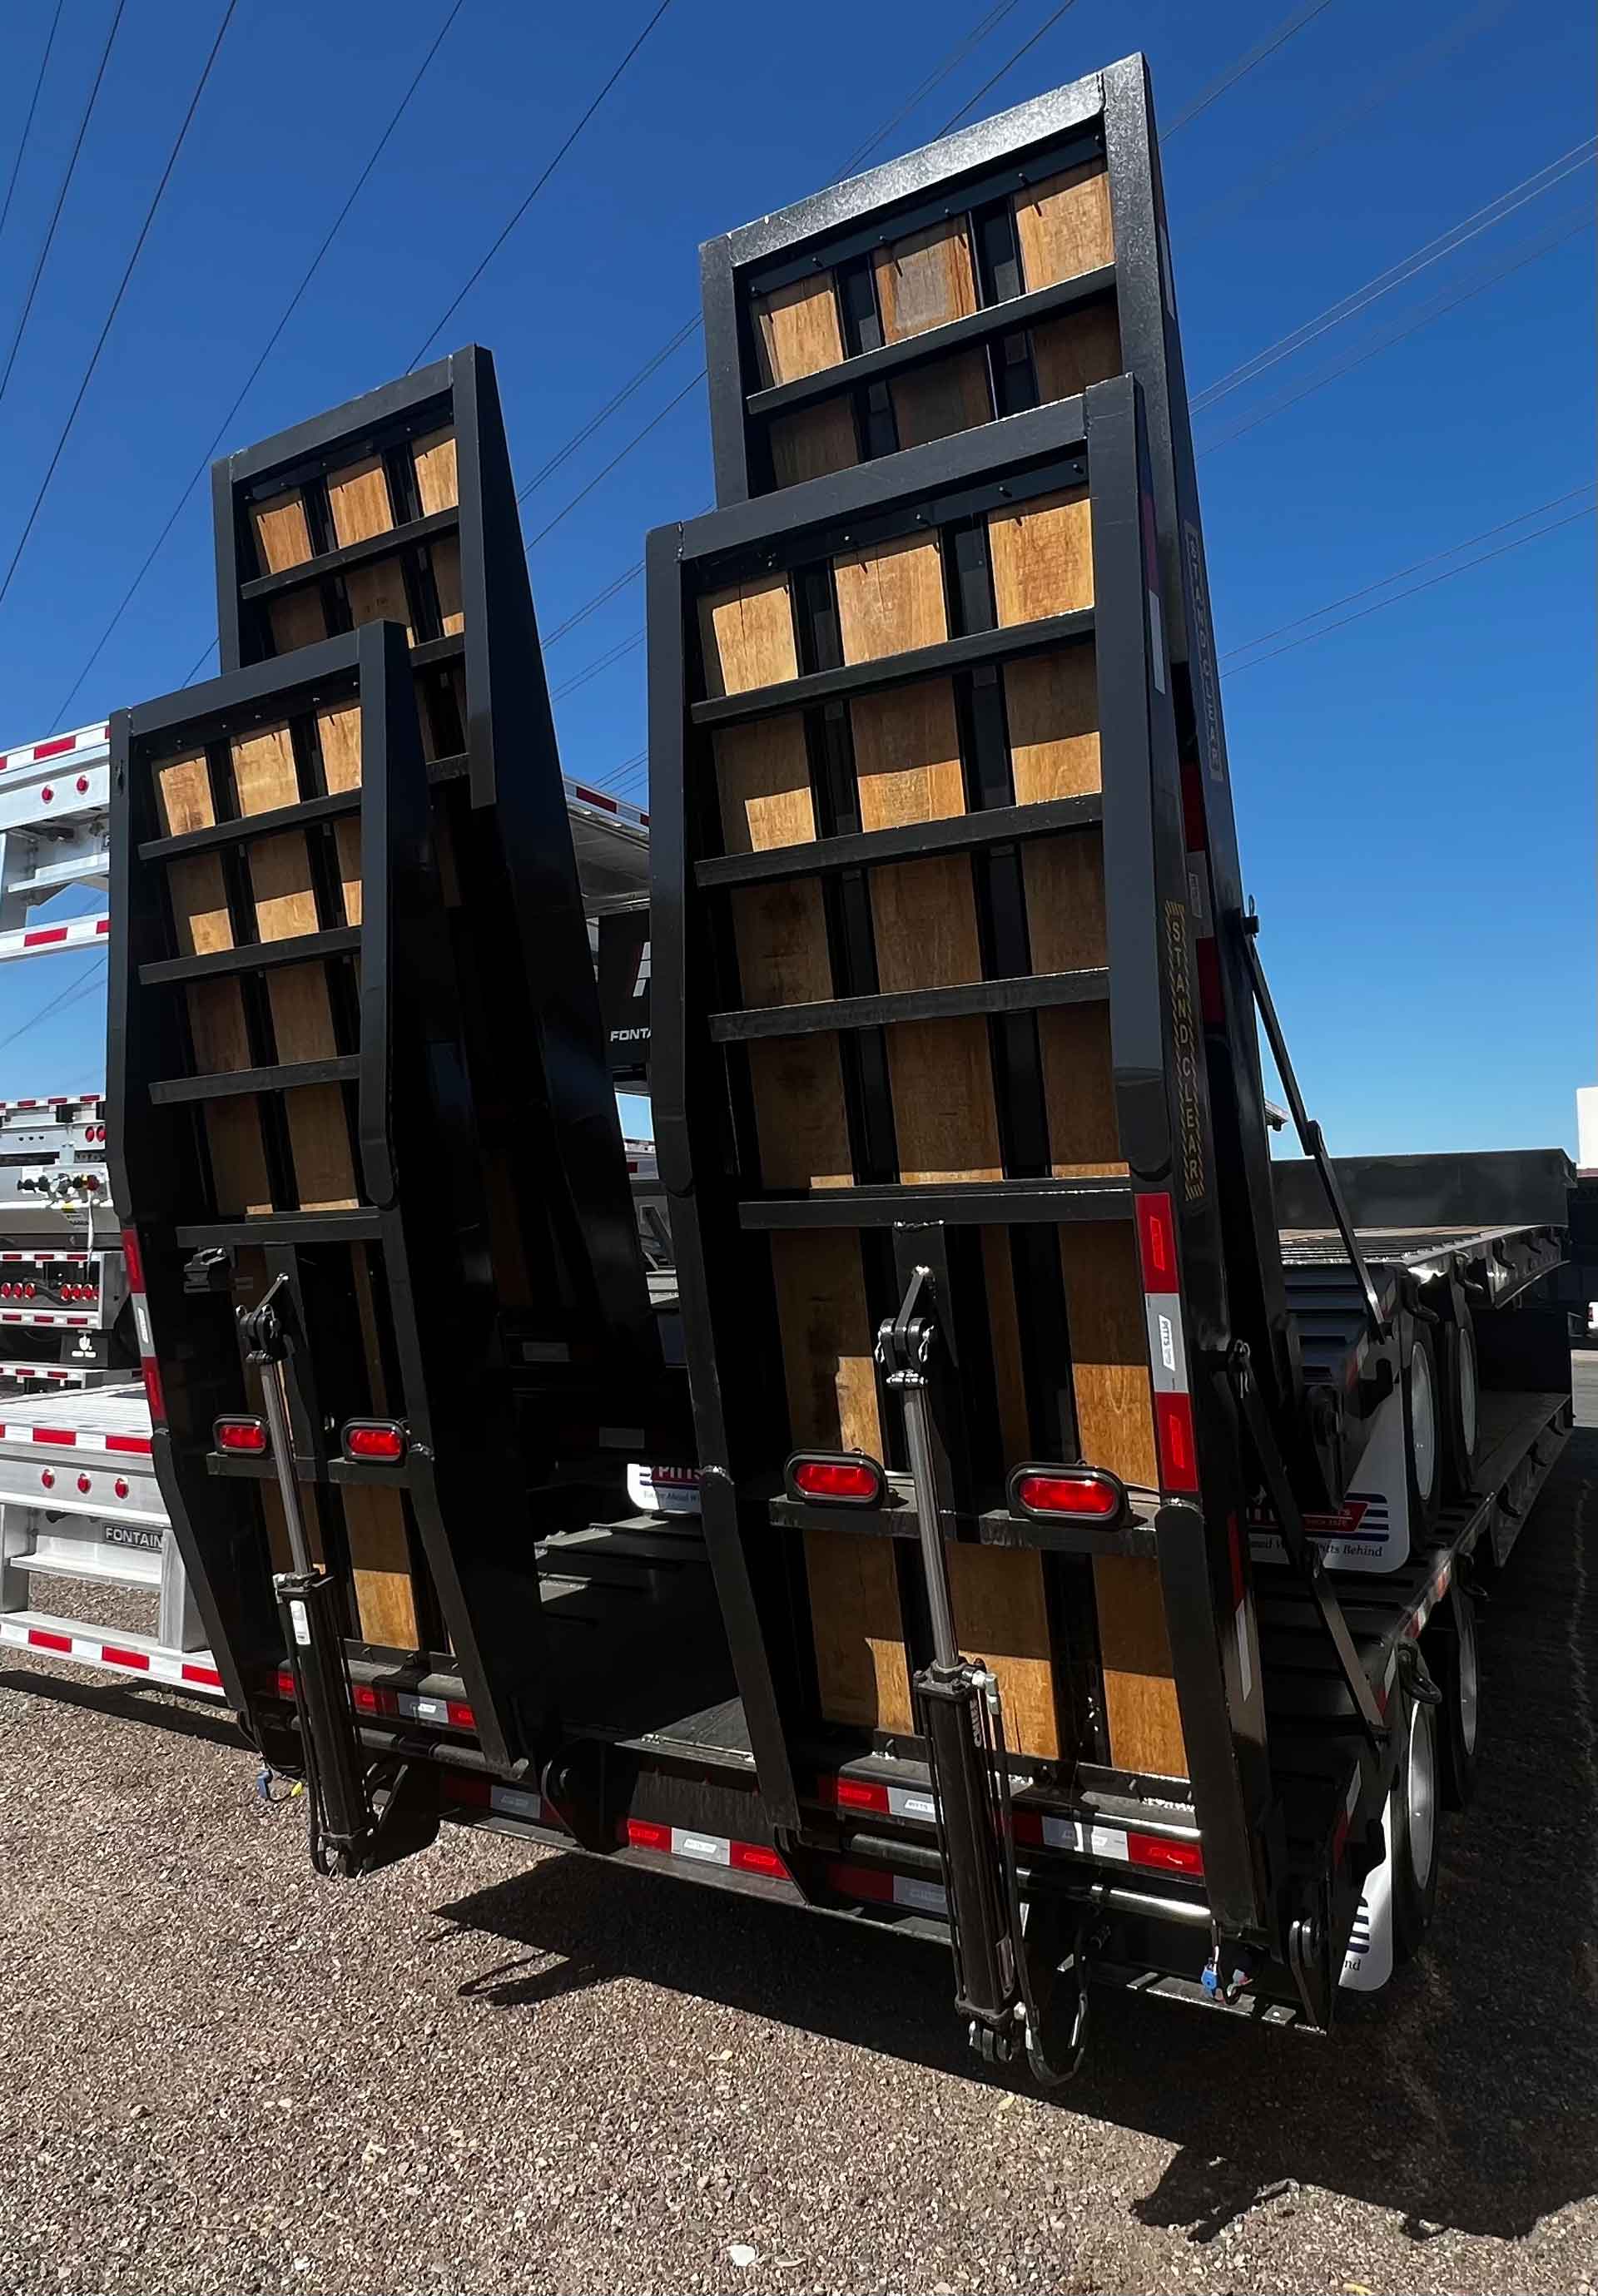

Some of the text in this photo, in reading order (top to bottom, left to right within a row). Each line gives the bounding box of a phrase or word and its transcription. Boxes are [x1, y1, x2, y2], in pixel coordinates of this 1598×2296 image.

[1189, 543, 1218, 761] STAND CLEAR
[1171, 920, 1198, 1178] STAND CLEAR
[1161, 1320, 1171, 1346] PITTS
[1343, 1544, 1382, 1557] Behind
